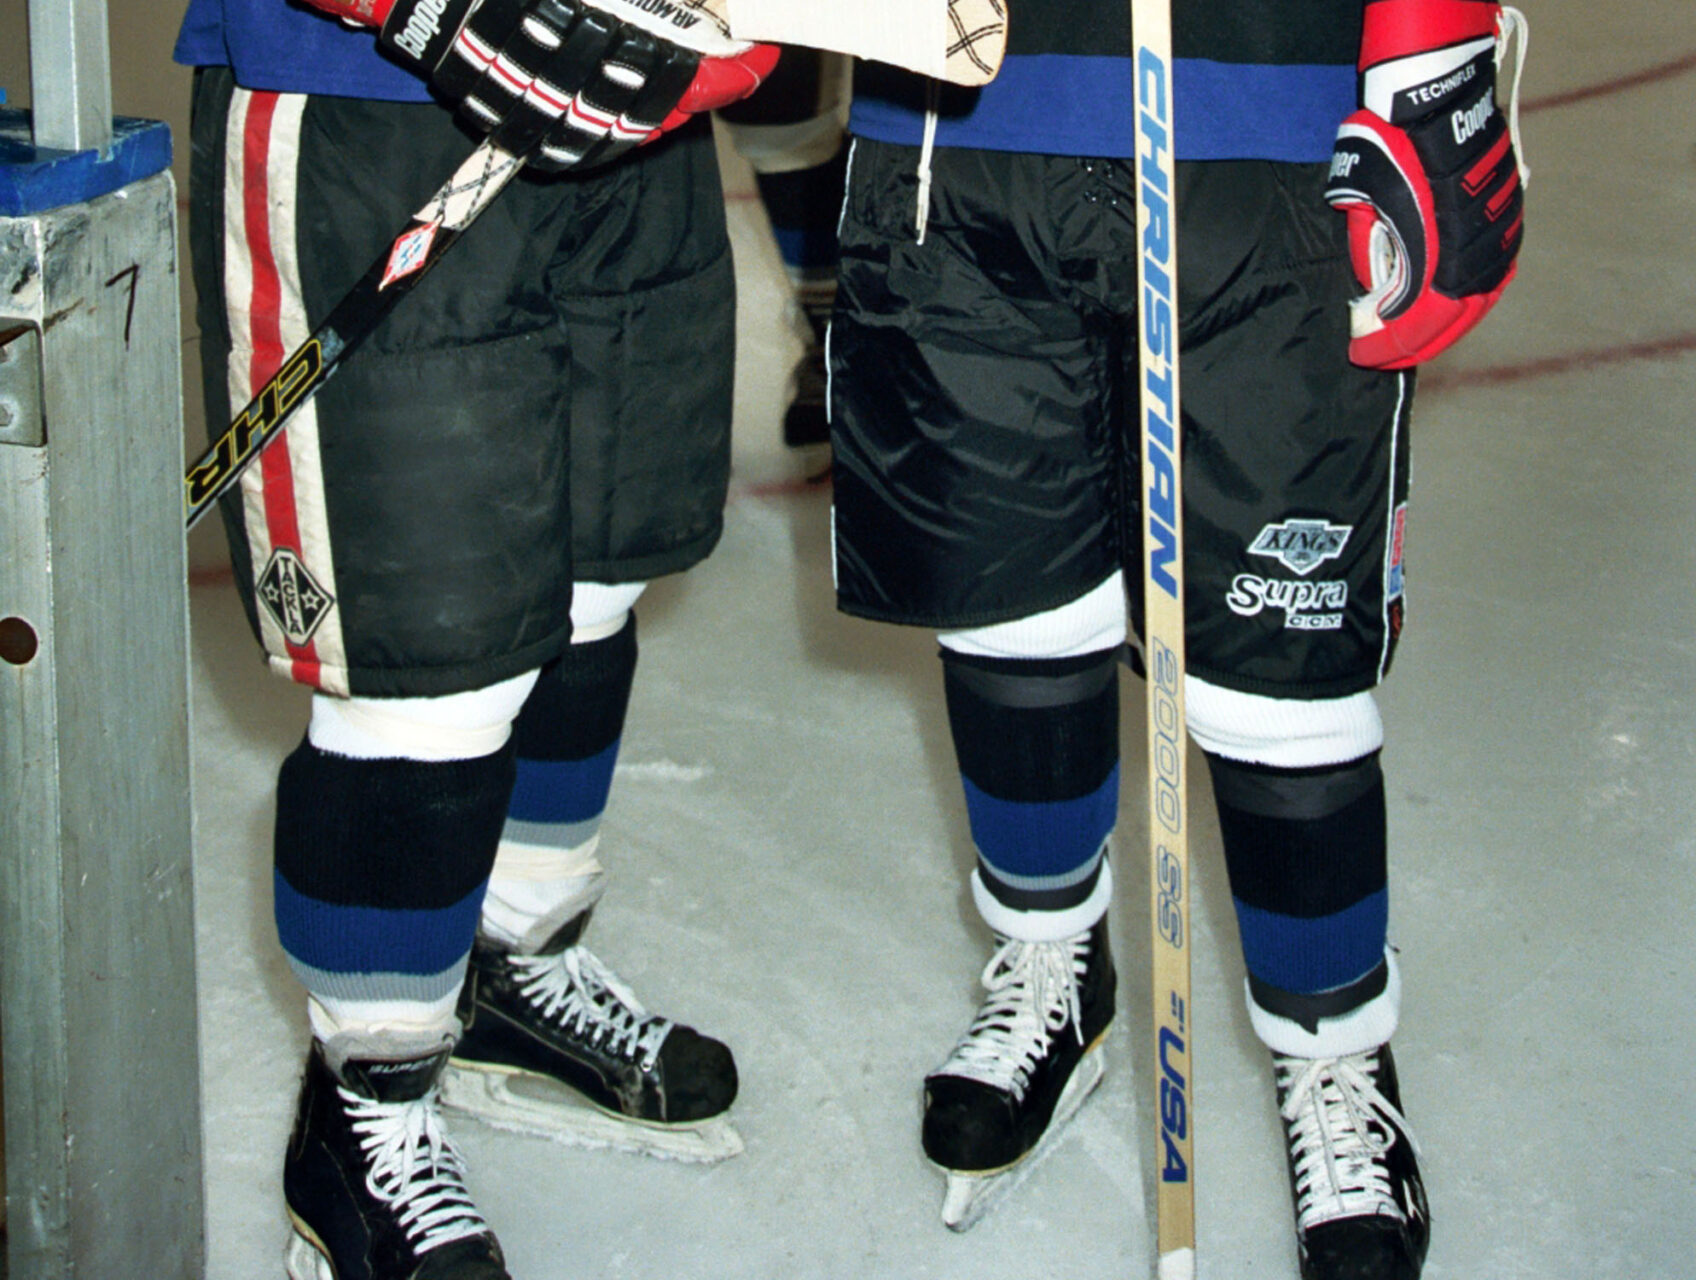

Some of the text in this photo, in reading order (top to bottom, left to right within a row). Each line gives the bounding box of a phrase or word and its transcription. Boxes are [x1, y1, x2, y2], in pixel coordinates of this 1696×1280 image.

[1263, 528, 1343, 551] KINGS
[279, 556, 302, 635] TACKLA
[1138, 45, 1188, 1183] CHRISTIAN 2000 SS USA
[1227, 573, 1348, 616] Supra
